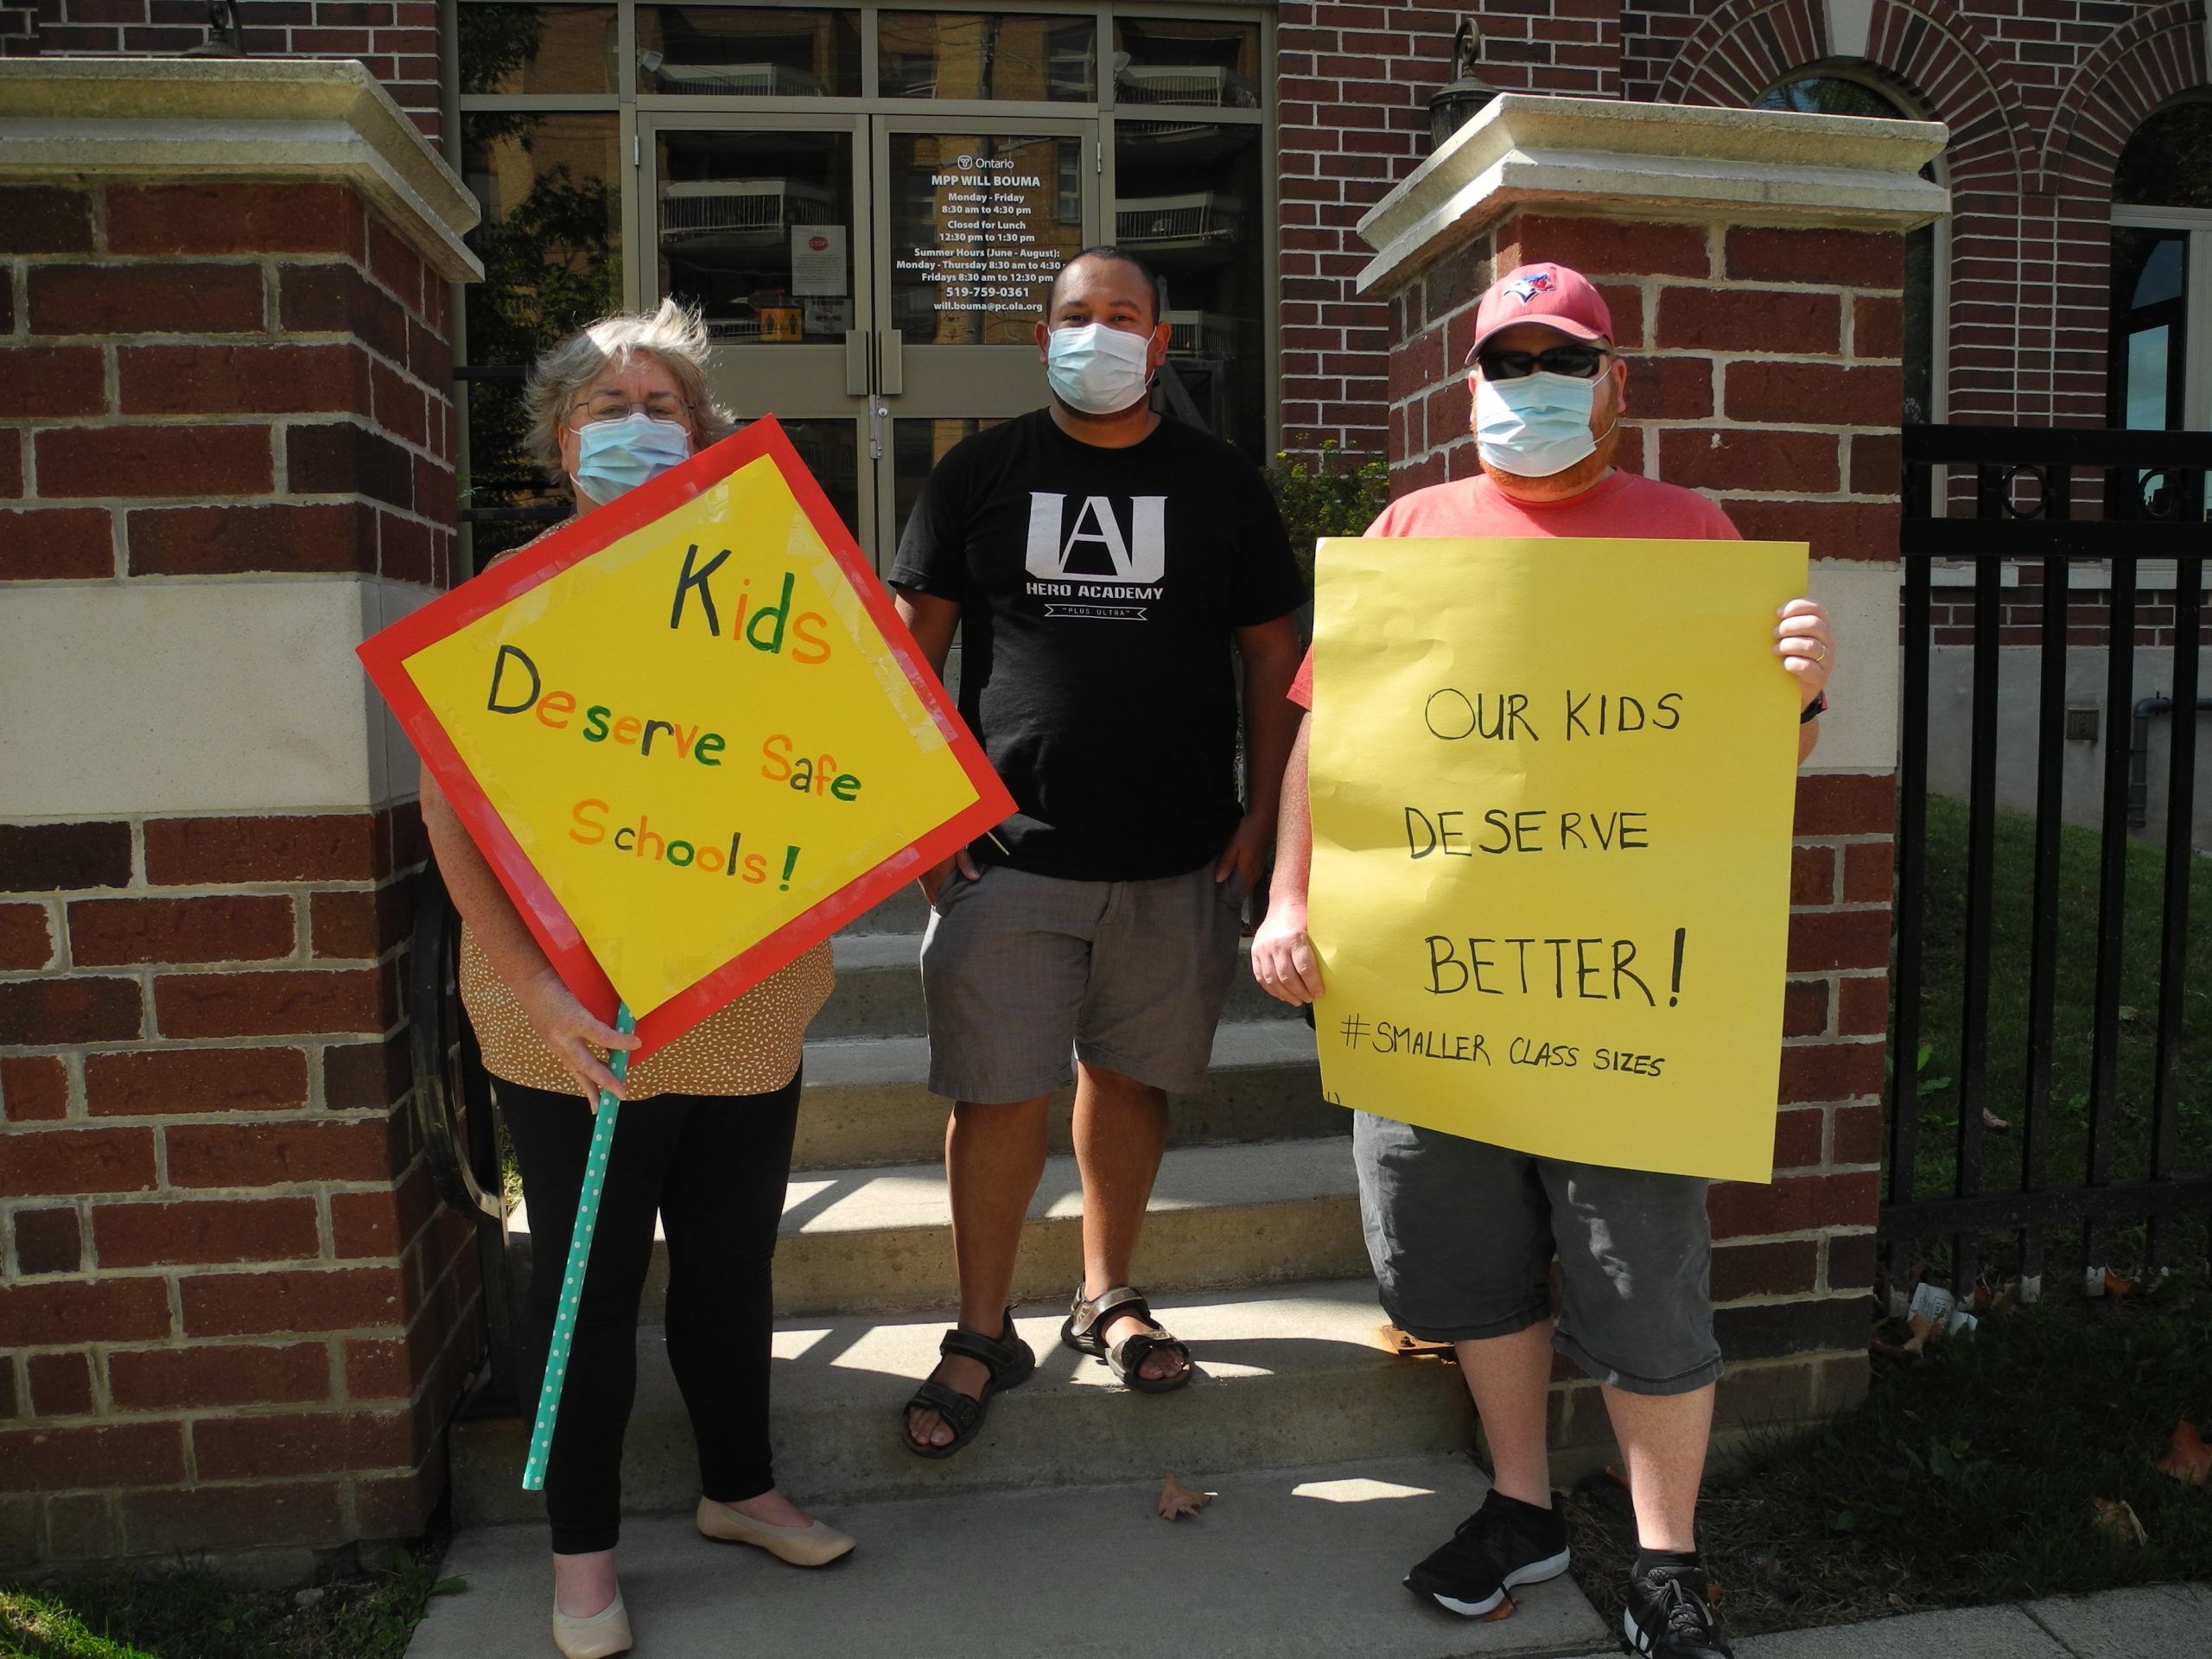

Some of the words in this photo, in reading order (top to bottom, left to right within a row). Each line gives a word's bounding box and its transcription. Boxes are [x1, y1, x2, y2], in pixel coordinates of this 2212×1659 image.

[976, 158, 1014, 169] Ontario
[931, 175, 959, 186] MPP
[961, 175, 991, 187] WILL
[994, 175, 1040, 188] BOUMA
[948, 193, 987, 204] Monday
[995, 194, 1025, 204] Friday
[942, 205, 963, 214] 8:30
[982, 206, 992, 214] to
[993, 206, 1014, 215] 4:30
[1016, 207, 1032, 216] pm
[947, 220, 980, 229] Closed
[982, 220, 995, 230] for
[997, 221, 1027, 230] Lunch
[939, 233, 966, 242] 12:30
[968, 234, 983, 243] pm
[997, 233, 1018, 242] 1:30
[1020, 234, 1035, 244] pm
[914, 247, 955, 257] Summer
[956, 248, 985, 257] Hours
[987, 248, 1013, 258] (June
[1020, 249, 1060, 259] August):
[896, 260, 936, 270] Monday
[942, 260, 987, 271] Thursday
[988, 261, 1010, 270] 8:30
[1027, 261, 1039, 270] to
[1039, 261, 1061, 270] 4:30
[921, 272, 957, 283] Fridays
[958, 273, 980, 282] 8:30
[997, 273, 1008, 282] to
[1010, 273, 1037, 282] 12:30
[1038, 275, 1053, 283] pm
[945, 287, 1029, 297] 519-759-0361
[933, 302, 1043, 312] will.bouma@pc.ola.org
[1026, 582, 1071, 597] HERO
[1077, 585, 1164, 600] ACADEMY
[671, 544, 832, 664] Kids
[1424, 688, 1540, 741] OUR
[1565, 690, 1684, 741] KIDS
[487, 644, 727, 767] Deserve
[760, 734, 861, 802] Safe
[1404, 805, 1649, 860] DESERVE
[569, 798, 801, 892] Schools!
[1423, 927, 1687, 1007] BETTER!
[1340, 1013, 1491, 1067] #SMALLER
[1509, 1036, 1579, 1069] CLASS
[1593, 1048, 1667, 1077] SIZES
